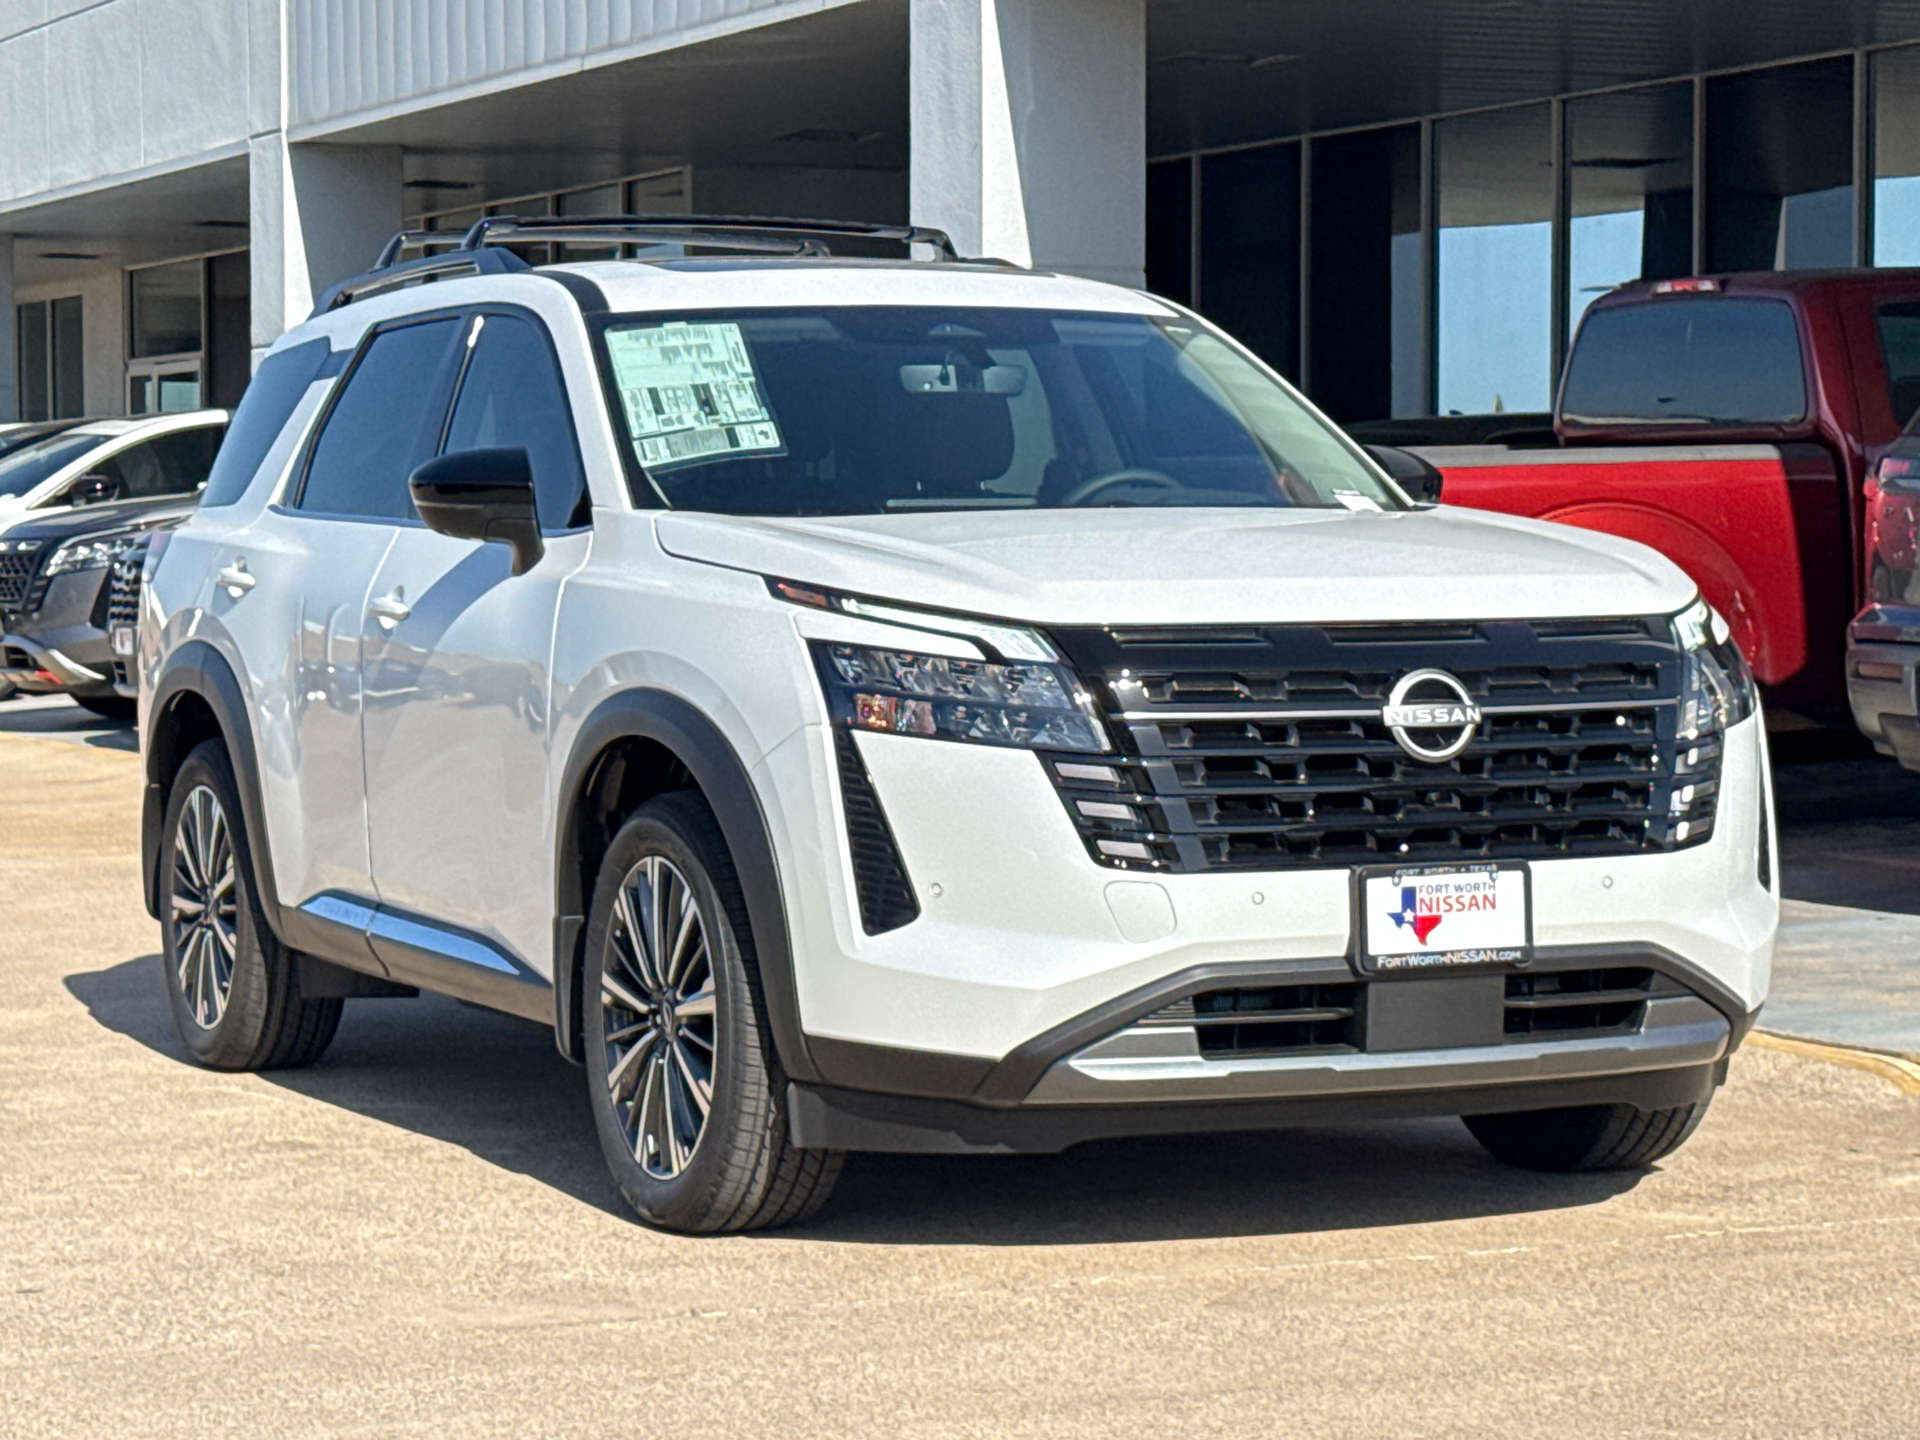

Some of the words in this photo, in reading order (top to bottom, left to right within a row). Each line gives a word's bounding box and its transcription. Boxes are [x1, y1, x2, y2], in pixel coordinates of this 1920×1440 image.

[1386, 707, 1480, 723] NISSAN
[1395, 868, 1420, 876] FORT
[1419, 884, 1450, 895] FORT
[1453, 882, 1496, 893] WORTH
[1419, 893, 1496, 913] NISSAN
